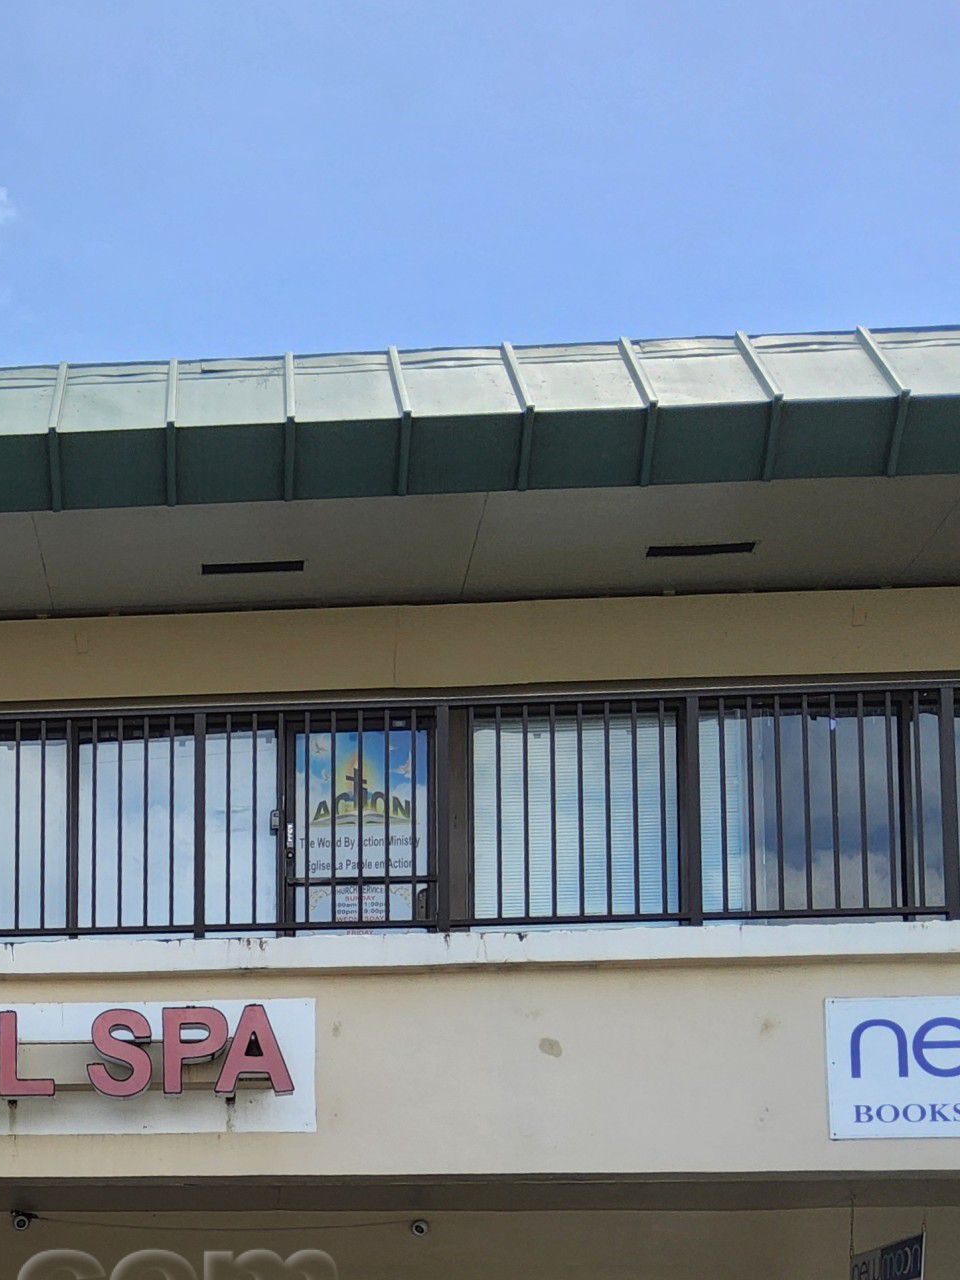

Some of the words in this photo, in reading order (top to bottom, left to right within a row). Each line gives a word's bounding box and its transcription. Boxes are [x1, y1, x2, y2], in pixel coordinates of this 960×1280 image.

[344, 836, 355, 850] By
[357, 835, 384, 848] ction
[86, 1003, 295, 1098] SPA
